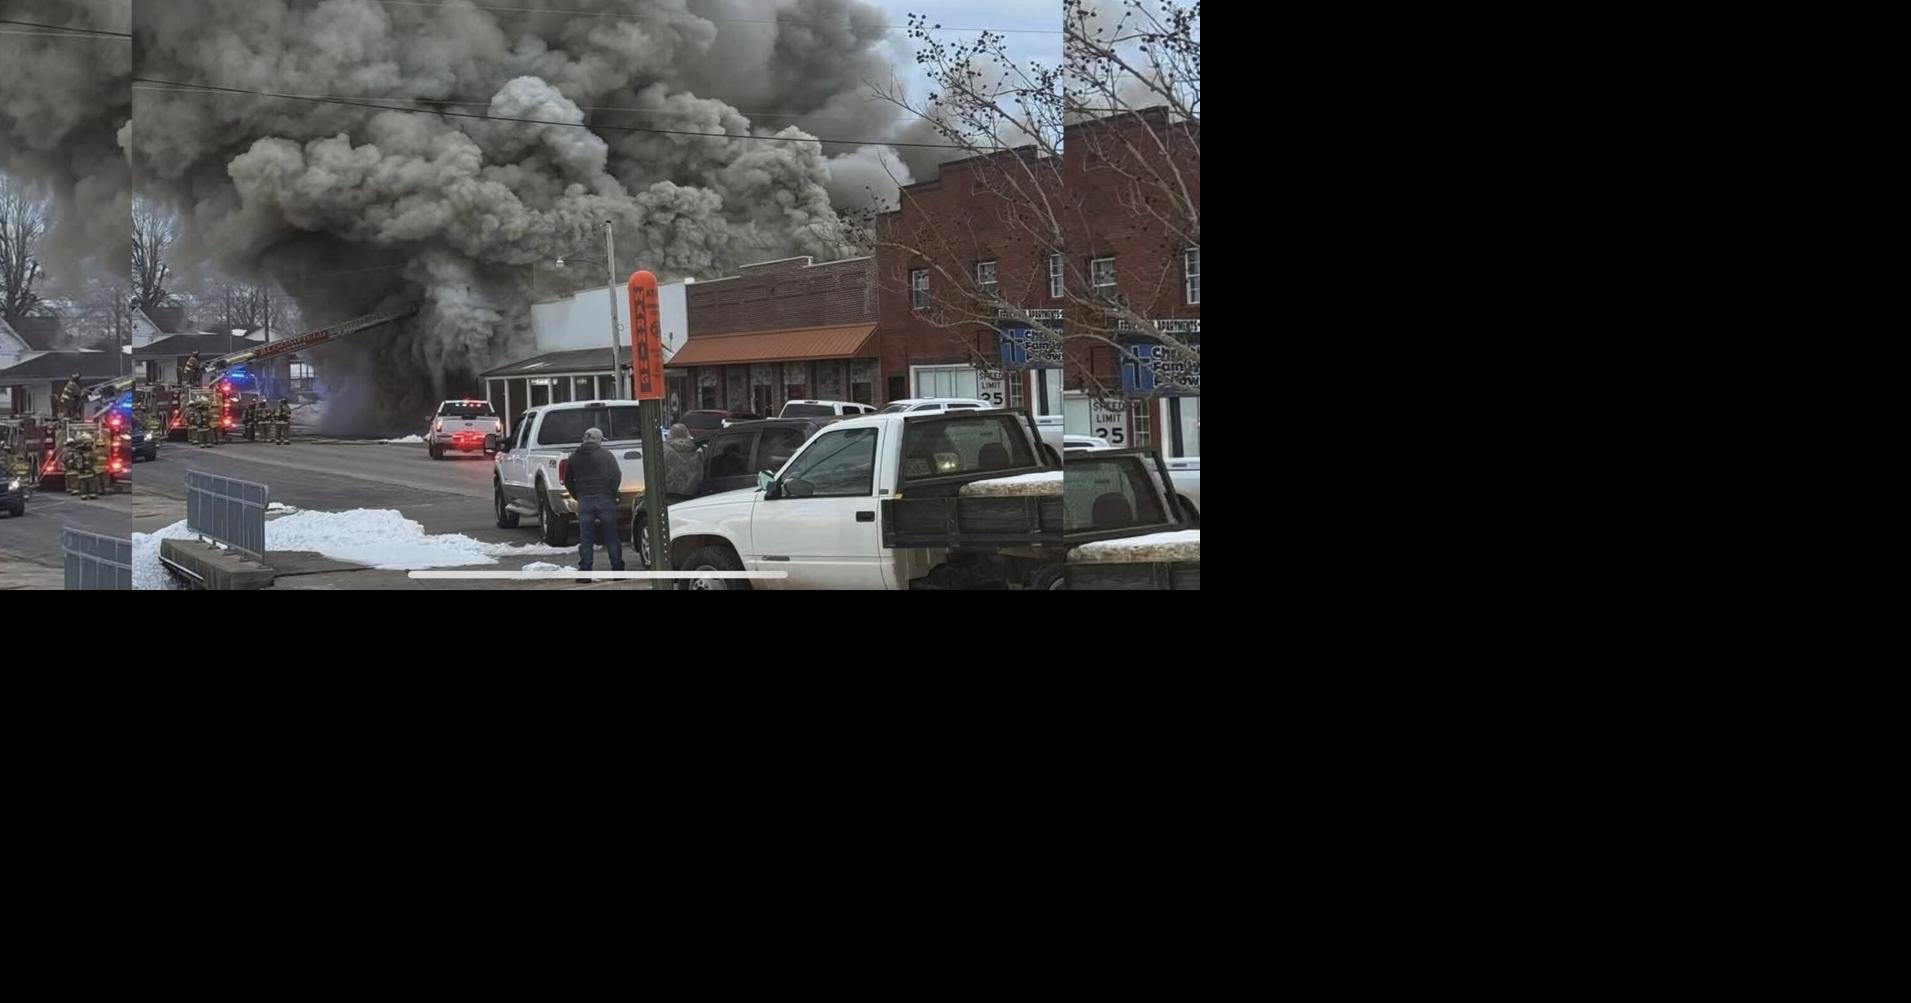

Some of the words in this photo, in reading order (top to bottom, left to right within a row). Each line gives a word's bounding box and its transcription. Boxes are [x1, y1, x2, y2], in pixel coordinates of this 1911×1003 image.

[634, 287, 650, 384] WARNING
[1096, 413, 1121, 423] LIMIT
[1096, 427, 1124, 444] 25
